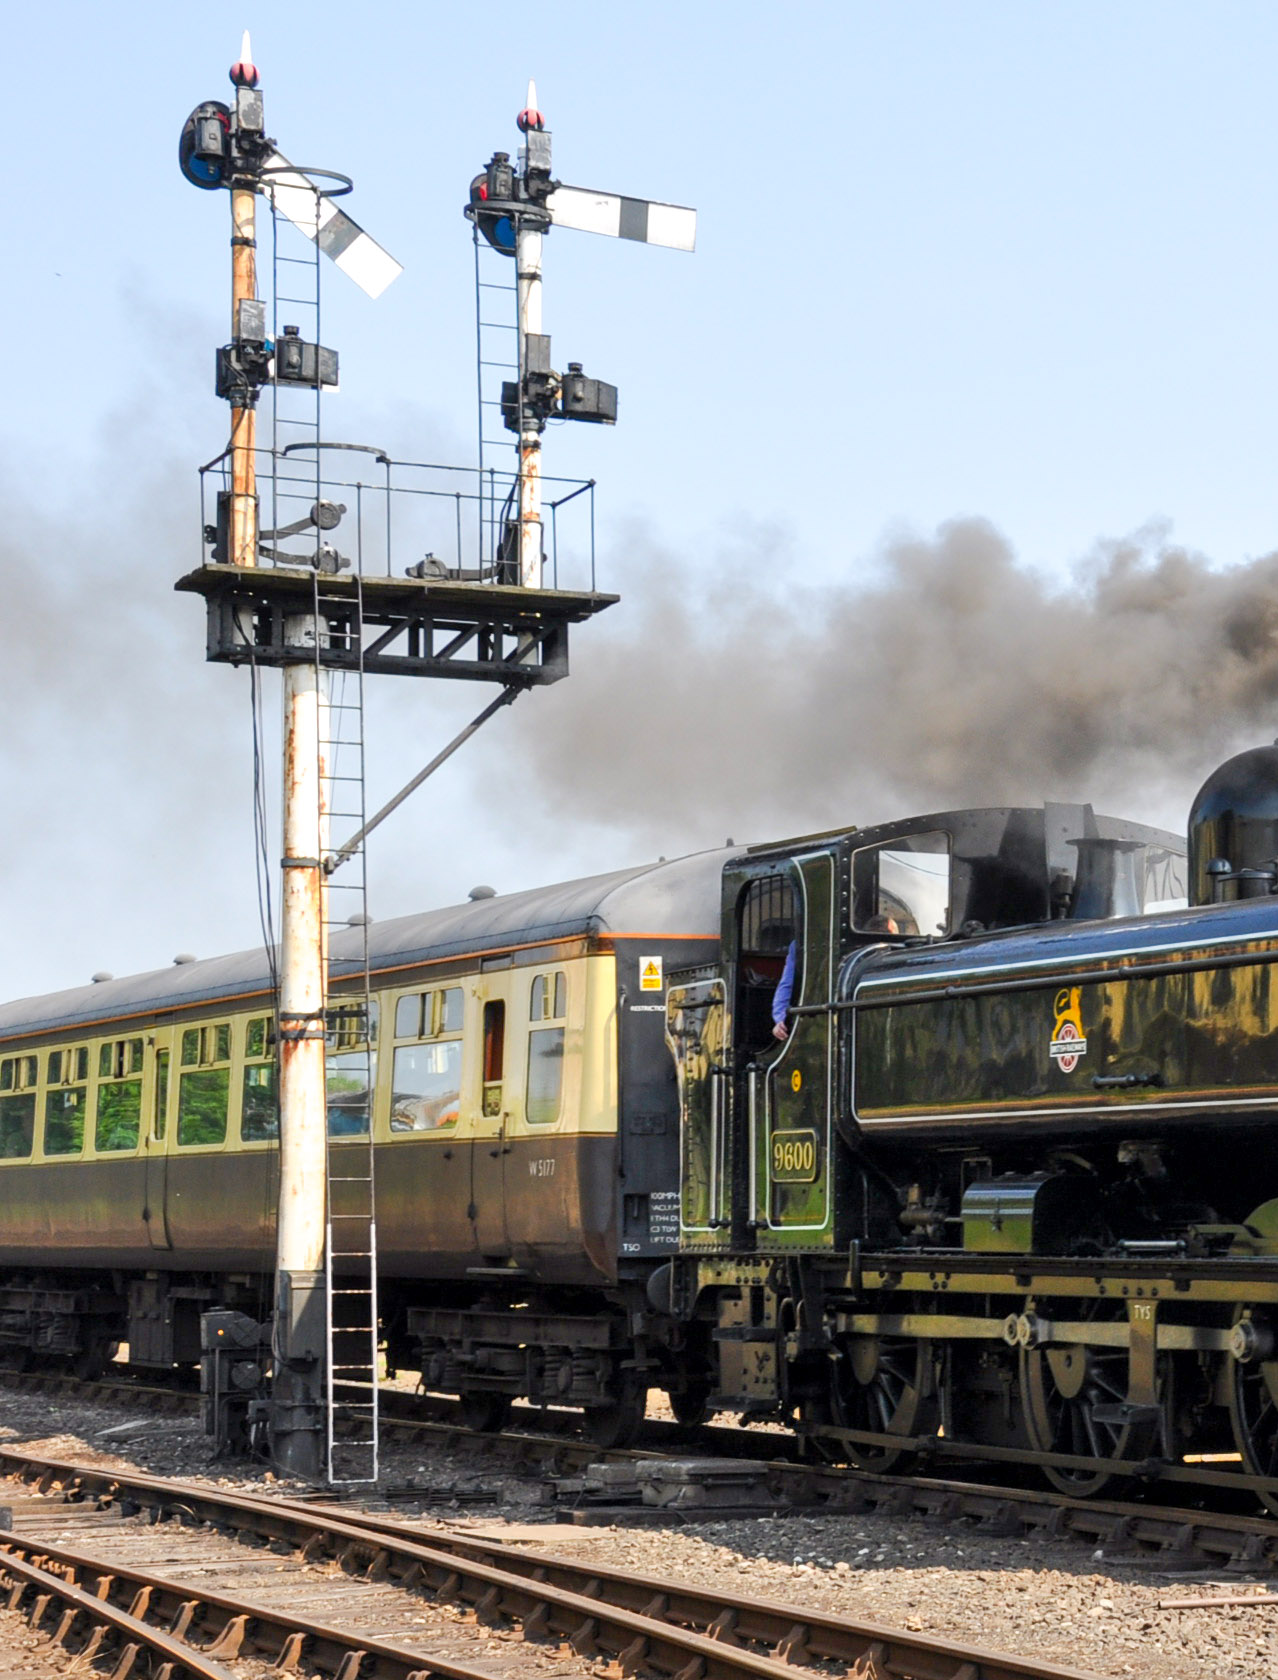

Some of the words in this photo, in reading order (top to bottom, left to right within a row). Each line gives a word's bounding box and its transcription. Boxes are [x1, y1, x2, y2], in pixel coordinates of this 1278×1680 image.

[774, 1142, 813, 1171] 9600
[528, 1160, 538, 1176] W
[538, 1159, 555, 1176] 5177
[622, 1243, 641, 1252] TSO
[1134, 1304, 1151, 1320] TYS
